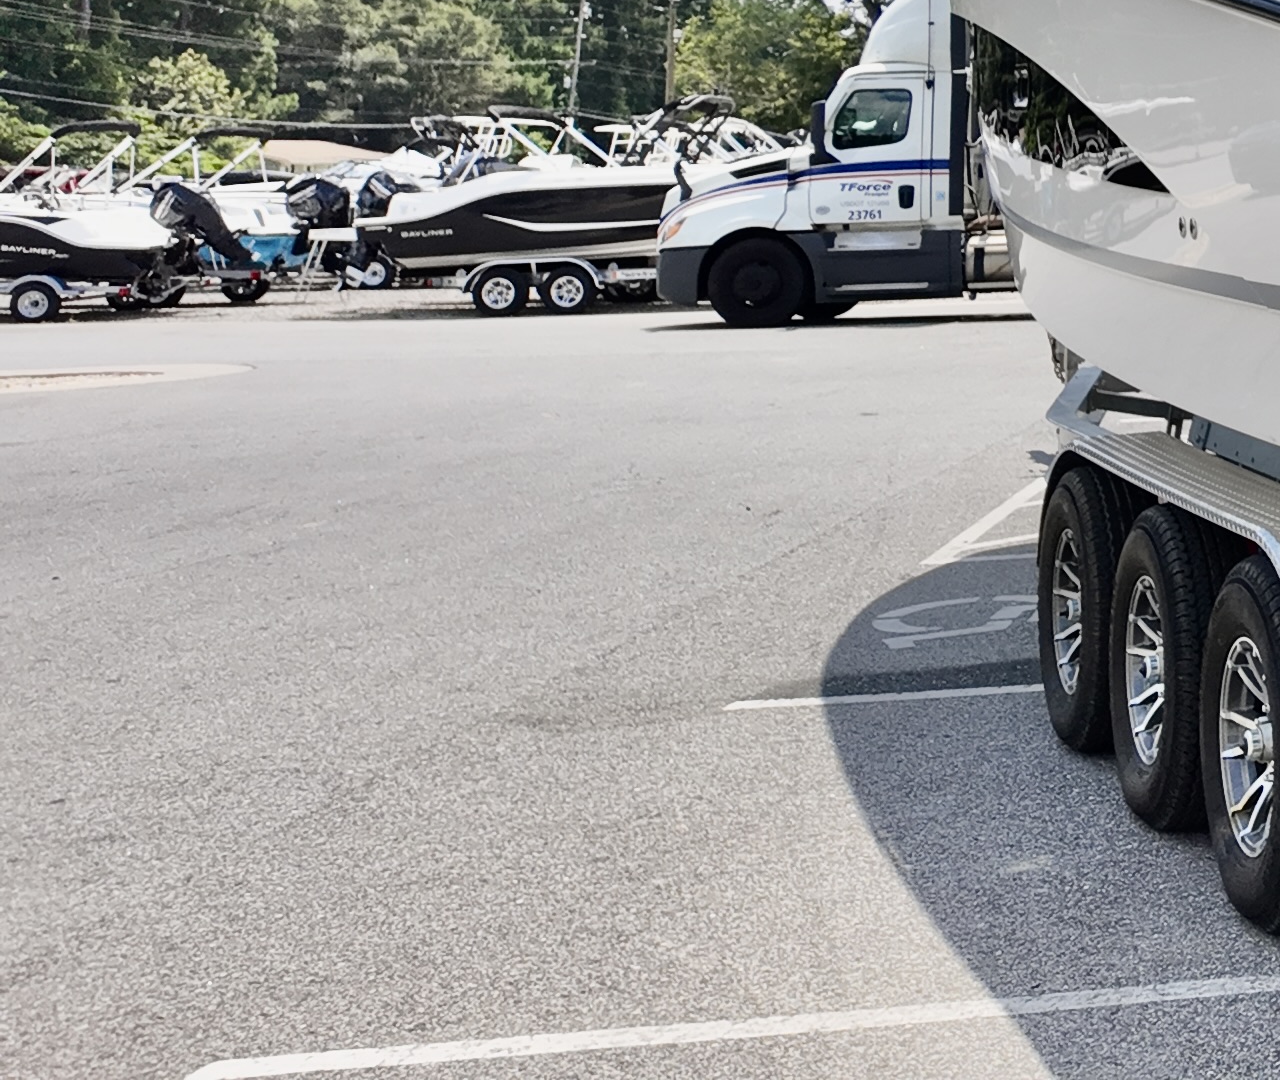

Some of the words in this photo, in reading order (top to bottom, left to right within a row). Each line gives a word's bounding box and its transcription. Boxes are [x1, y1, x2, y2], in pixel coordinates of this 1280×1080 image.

[840, 182, 891, 192] TForce
[848, 209, 882, 221] 23761
[400, 228, 453, 239] BAYLINER
[0, 244, 57, 256] BAYLINER
